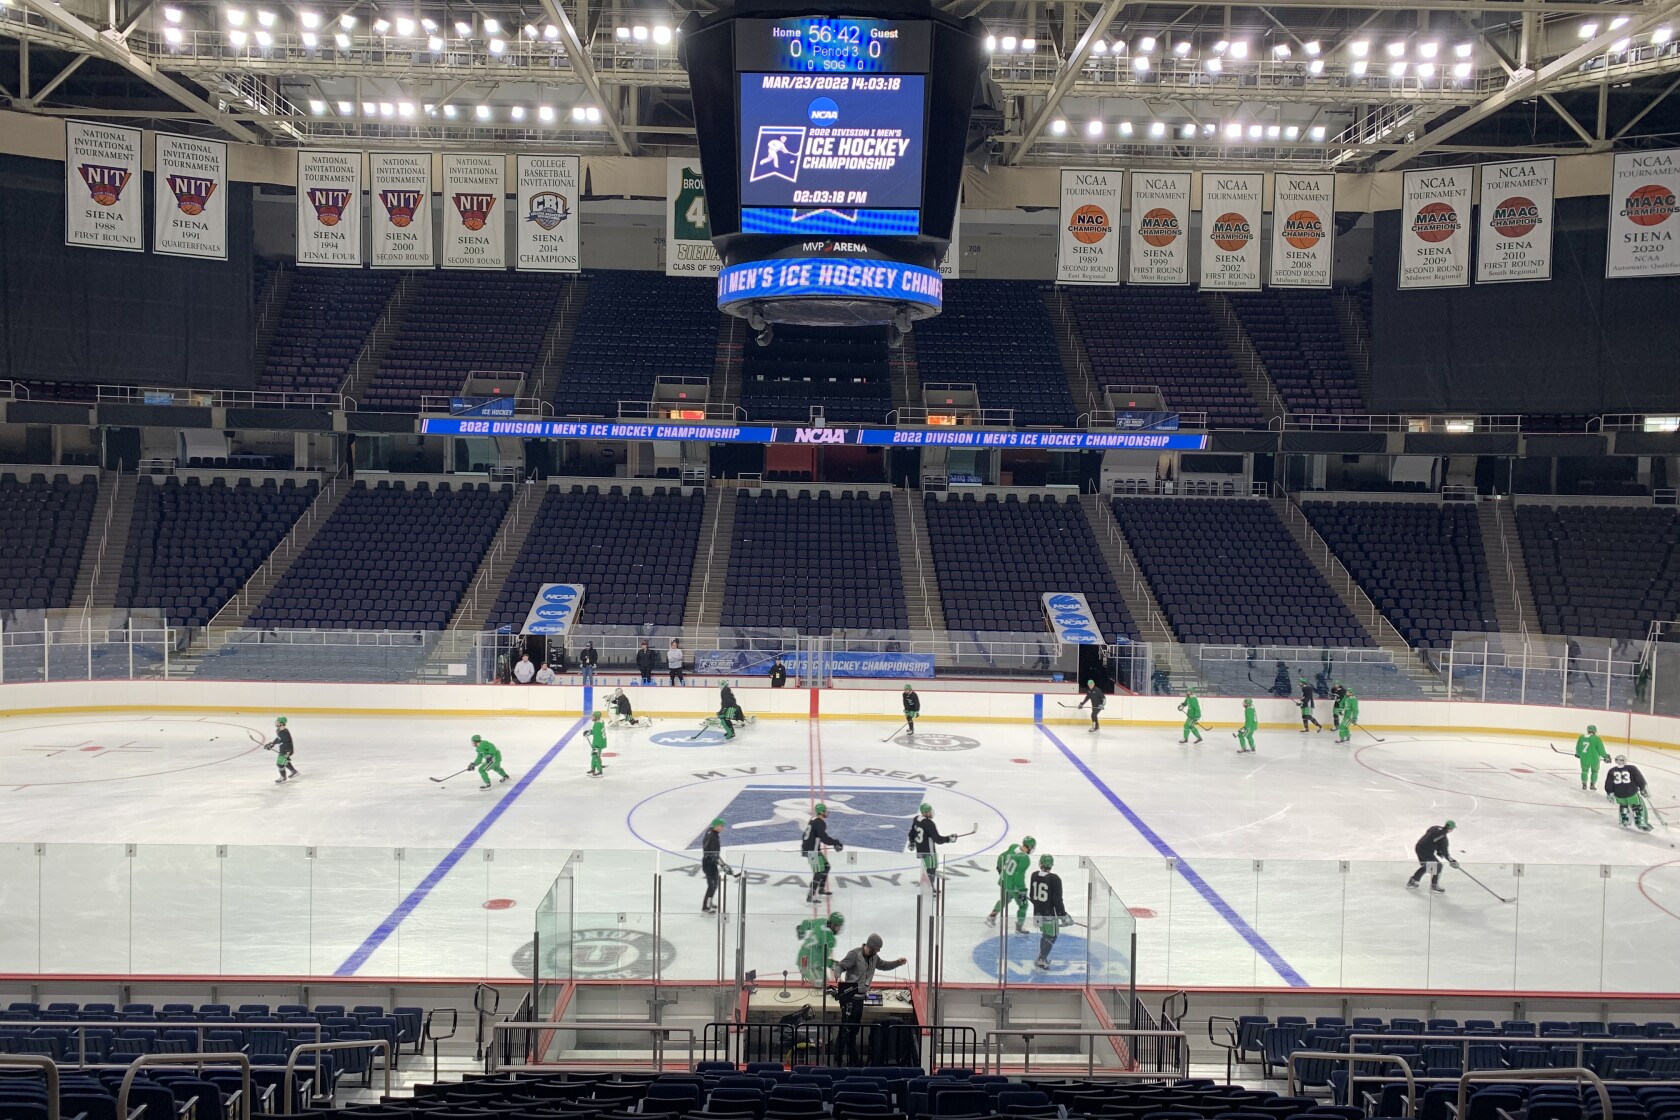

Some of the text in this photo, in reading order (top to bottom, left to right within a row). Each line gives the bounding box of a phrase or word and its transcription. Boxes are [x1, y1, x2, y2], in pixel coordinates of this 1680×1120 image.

[773, 27, 801, 37] Home
[809, 25, 860, 43] 56:42
[870, 28, 899, 38] Guest
[790, 39, 802, 57] 0
[813, 46, 859, 57] Period 3
[869, 40, 881, 58] 0
[808, 60, 864, 70] 0 SOG 0
[762, 75, 901, 90] MAR/23/2022 14:03:18
[811, 110, 838, 119] NCAA
[83, 129, 126, 141] NATIONAL
[809, 128, 830, 136] 2022
[831, 128, 870, 137] DIVISION
[876, 129, 902, 137] MEN'S
[74, 138, 134, 151] INVITATIONAL
[171, 141, 212, 153] NATIONAL
[805, 137, 910, 157] ICE HOCKEY
[74, 147, 134, 160] TOURNAMENT
[163, 150, 220, 163] INVITATIONAL
[163, 159, 220, 172] TOURNAMENT
[530, 159, 566, 168] COLLEGE
[803, 156, 896, 170] CHAMPIONSHIP
[1632, 155, 1673, 168] NCAA
[305, 165, 354, 173] INVITATIONAL
[376, 167, 426, 175] INVITATIONAL
[449, 167, 498, 175] INVITATIONAL
[524, 169, 572, 178] BASKETBALL
[1498, 166, 1536, 178] NCAA
[87, 167, 125, 187] NIT
[305, 174, 355, 182] TOURNAMENT
[449, 176, 499, 185] TOURNAMENT
[1076, 175, 1107, 185] NCAA
[174, 178, 211, 196] NIT
[520, 178, 576, 187] INVITATIONAL
[1145, 179, 1176, 190] NCAA
[1217, 180, 1248, 190] NCAA
[1289, 180, 1320, 191] NCAA
[1420, 177, 1456, 189] NCAA
[1487, 178, 1549, 190] TOURNAMENT
[793, 190, 868, 204] 02:03:18 PM
[1065, 188, 1117, 196] TOURNAMENT
[1207, 192, 1258, 200] TOURNAMENT
[1279, 193, 1330, 201] TOURNAMENT
[1408, 189, 1468, 200] TOURNAMENT
[315, 190, 346, 206] NIT
[387, 192, 418, 208] NIT
[1625, 194, 1676, 209] MAAC
[460, 195, 491, 212] NIT
[85, 210, 124, 221] SIENA
[685, 196, 707, 228] 4
[1494, 206, 1538, 218] MAAC
[1620, 206, 1680, 217] CHAMPIONS
[1077, 215, 1104, 225] NAC
[1142, 218, 1178, 228] MAAC
[1416, 212, 1458, 224] MAAC
[1490, 218, 1543, 227] CHAMPIONS
[95, 222, 116, 231] 1988
[172, 220, 209, 230] SIENA
[1068, 225, 1112, 233] CHAMPIONS
[1214, 223, 1250, 232] MAAC
[1286, 220, 1322, 230] MAAC
[1411, 223, 1462, 232] CHAMPIONS
[182, 231, 200, 239] 1991
[313, 231, 346, 240] SIENA
[385, 233, 418, 241] SIENA
[1138, 228, 1182, 236] CHAMPIONS
[1623, 231, 1672, 243] SIENA
[74, 231, 136, 244] FIRST ROUND
[457, 236, 490, 245] SIENA
[532, 234, 564, 242] SIENA
[162, 240, 221, 251] QUARTERFINALS
[392, 243, 414, 251] 2000
[802, 241, 868, 252] MVP ARENA
[1072, 246, 1104, 254] SIENA
[1496, 241, 1533, 250] SIENA
[1632, 244, 1664, 253] 2020
[304, 252, 356, 260] FINAL FOUR
[1143, 249, 1174, 258] SIENA
[1286, 251, 1317, 259] SIENA
[1417, 247, 1452, 256] SIENA
[1502, 251, 1526, 260] 2010
[476, 257, 501, 265] ROUND
[520, 254, 577, 263] CHAMPIONS
[1079, 256, 1098, 264] 1989
[1149, 258, 1168, 266] 1999
[1423, 257, 1447, 266] 2009
[697, 263, 707, 271] OF
[728, 266, 774, 293] MEN'S
[779, 265, 812, 287] ICE
[818, 264, 898, 289] HOCKEY
[491, 408, 513, 416] HOCKEY
[459, 421, 741, 439] 2022 DIVISION I MEN'S ICE HOCKEY CHAMPIONSHIP
[794, 427, 845, 444] NCAA
[893, 431, 1170, 447] 2022 DIVISION I MEN'S ICE HOCKEY CHAMPIONSHIP
[861, 661, 930, 672] CHAMPIONSHIP
[1582, 741, 1590, 753] 7
[691, 764, 959, 788] MVP ARENA
[1612, 771, 1631, 785] 33
[1032, 881, 1049, 902] 16
